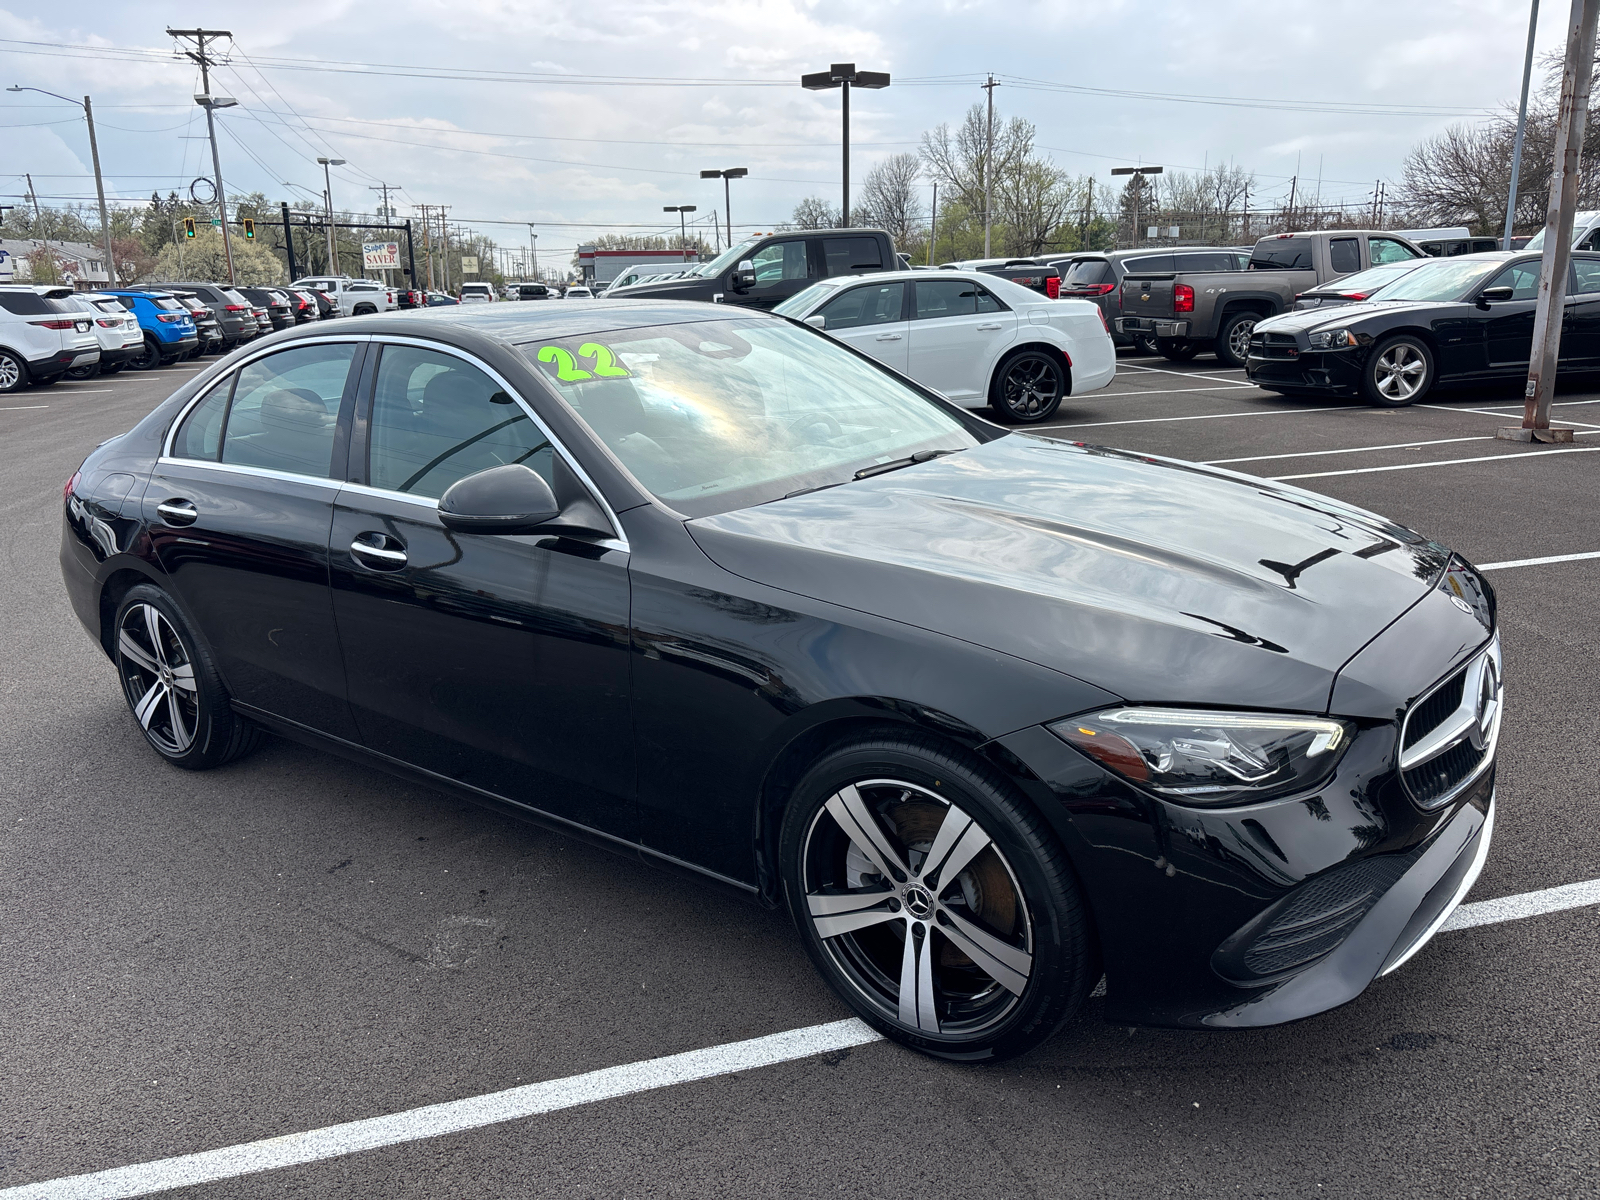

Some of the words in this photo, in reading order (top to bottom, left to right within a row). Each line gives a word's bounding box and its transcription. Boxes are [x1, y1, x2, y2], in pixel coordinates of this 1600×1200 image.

[364, 244, 386, 253] Super
[366, 254, 395, 264] SAVER
[1012, 277, 1042, 286] FX4
[537, 342, 633, 382] 22
